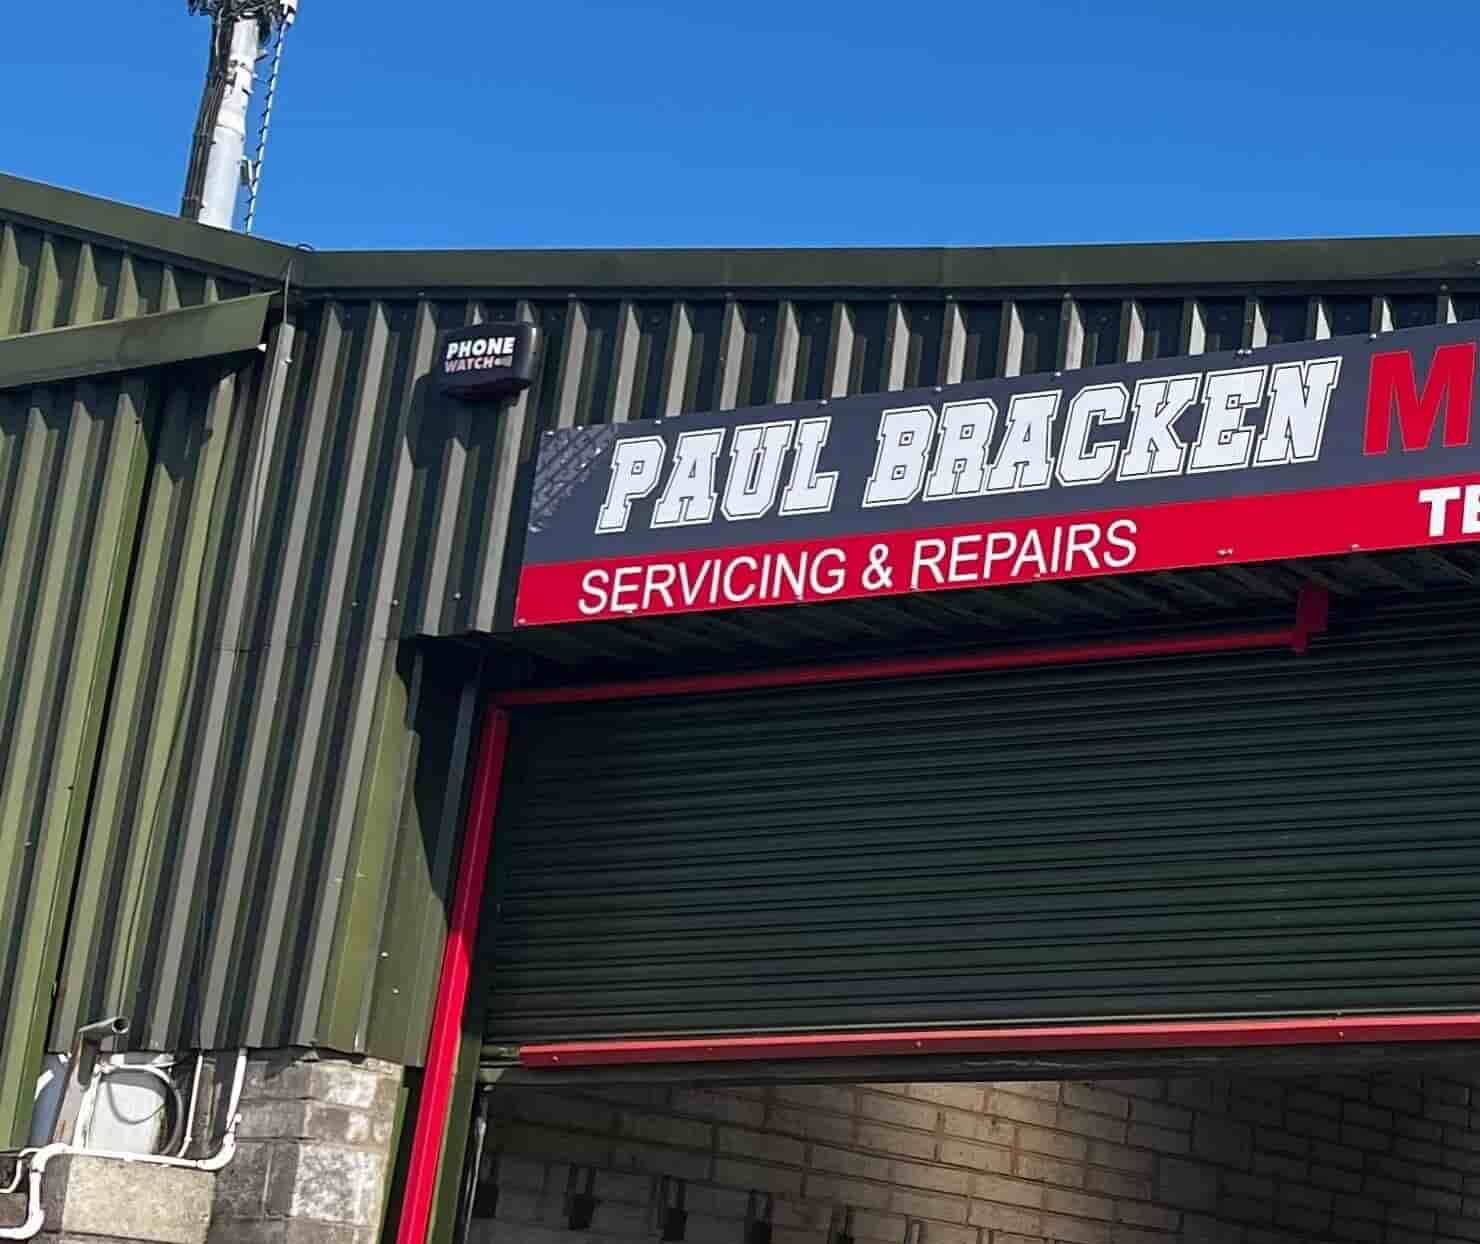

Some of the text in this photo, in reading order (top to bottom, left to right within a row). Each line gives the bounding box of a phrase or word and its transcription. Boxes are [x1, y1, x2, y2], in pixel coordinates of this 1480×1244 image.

[445, 355, 496, 372] WATCH
[446, 336, 515, 360] PHONE
[595, 416, 840, 535] PAUL
[863, 355, 1342, 508] BRACKEN
[577, 518, 1139, 616] SERVICING & REPAIRS
